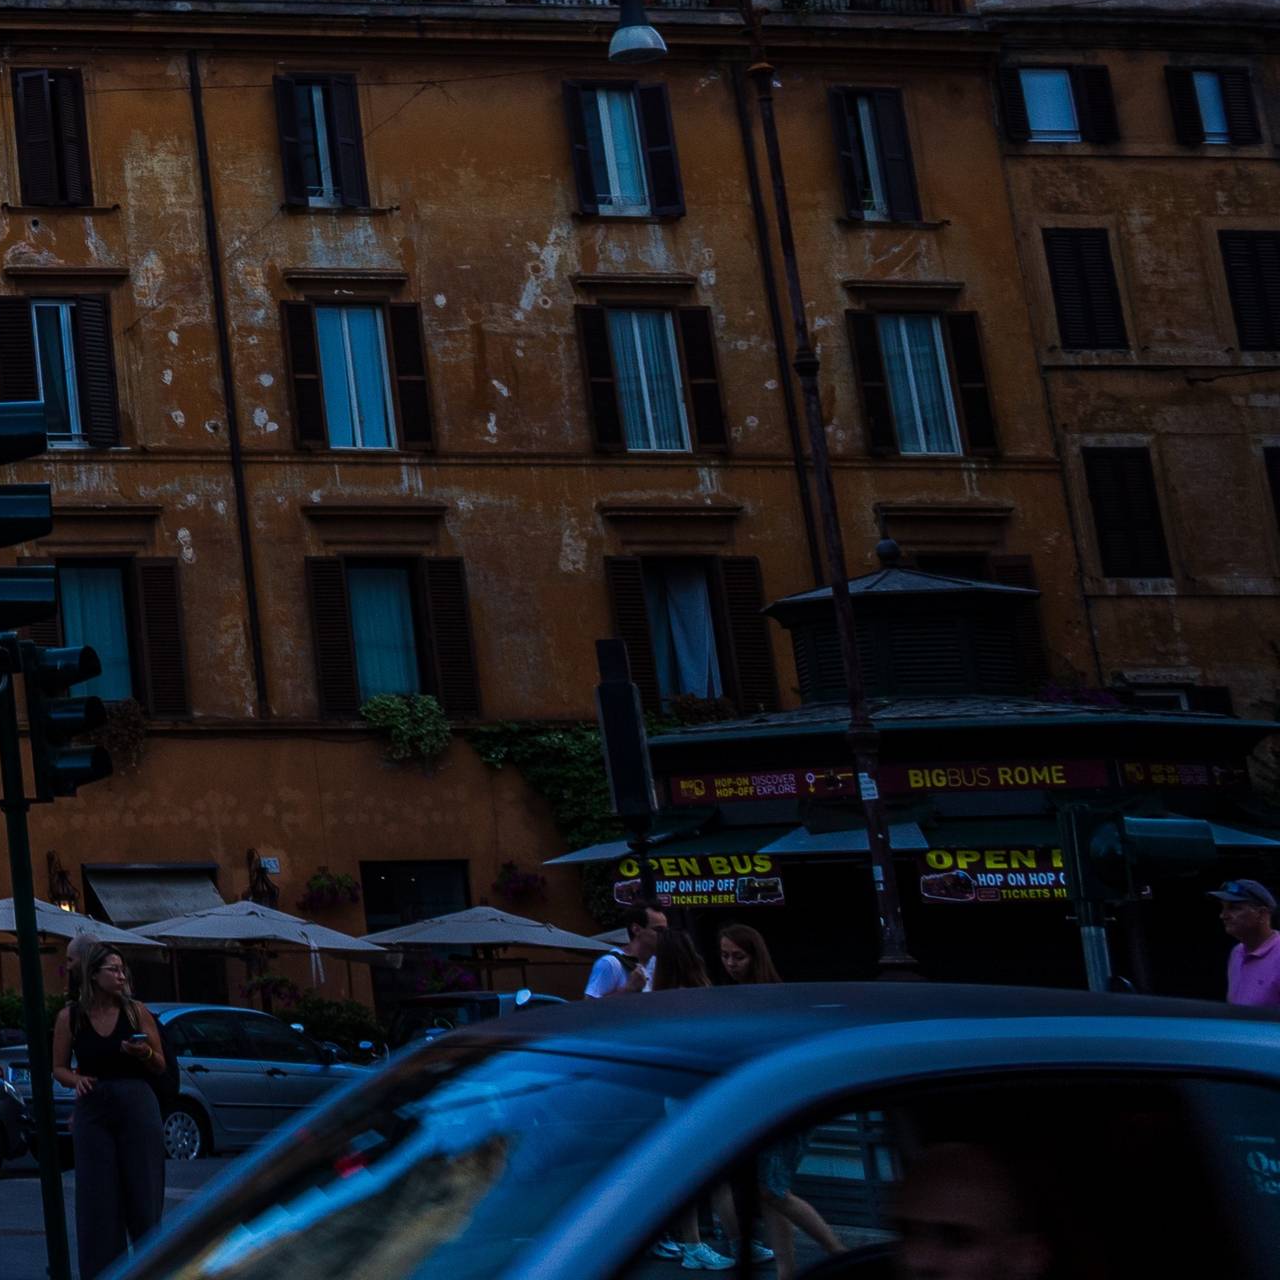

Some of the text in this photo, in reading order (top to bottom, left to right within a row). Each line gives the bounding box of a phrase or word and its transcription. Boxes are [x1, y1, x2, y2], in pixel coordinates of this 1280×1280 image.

[714, 774, 796, 787] HOP-ON DISCOVER
[908, 765, 1067, 789] BIGBUS ROME
[716, 785, 798, 798] HOP-OFF EXPLORE
[708, 854, 773, 875] BUS
[925, 848, 1037, 870] OPEN
[656, 878, 735, 893] HOP ON HOP OFF
[977, 873, 1003, 887] HOP
[1007, 873, 1026, 886] ON
[1029, 872, 1055, 886] HOP
[672, 894, 709, 905] TICKETS
[710, 893, 736, 904] HERE
[1000, 887, 1051, 899] TICKETS
